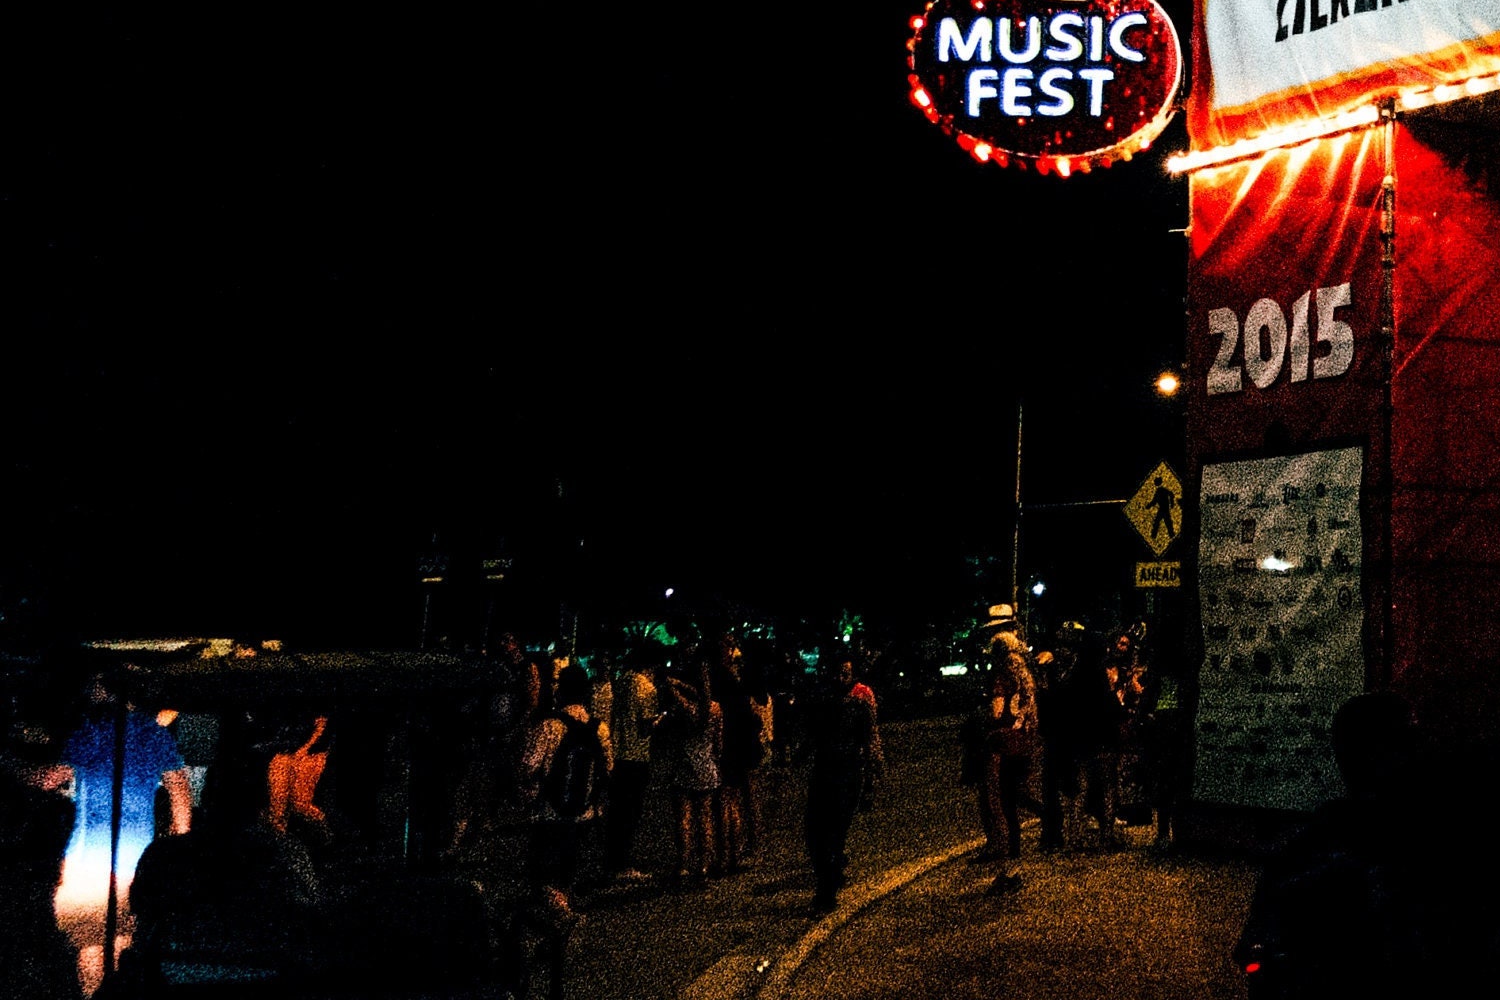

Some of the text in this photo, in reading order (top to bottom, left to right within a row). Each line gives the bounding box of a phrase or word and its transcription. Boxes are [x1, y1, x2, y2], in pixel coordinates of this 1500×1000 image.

[936, 12, 1147, 64] MUSIC
[965, 67, 1115, 119] FEST
[1206, 282, 1355, 397] 2015
[1141, 567, 1177, 581] AHEAD
